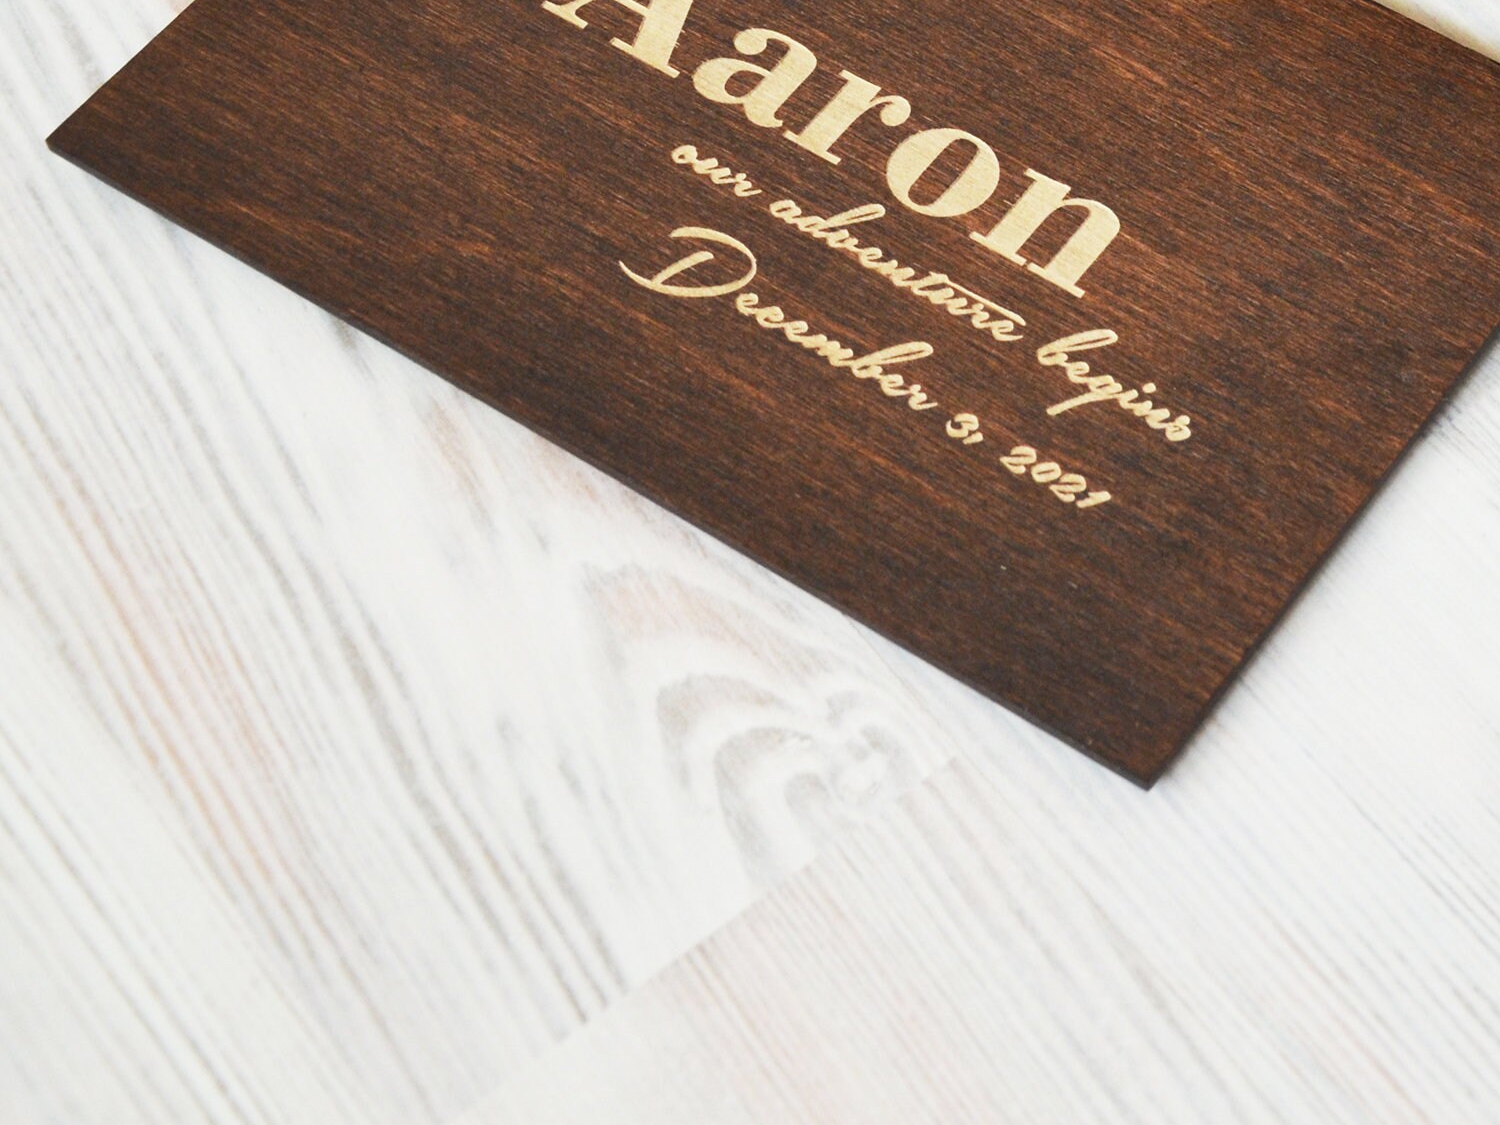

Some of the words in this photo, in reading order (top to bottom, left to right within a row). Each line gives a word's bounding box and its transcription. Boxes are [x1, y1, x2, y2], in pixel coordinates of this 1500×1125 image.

[618, 226, 939, 411] December
[999, 445, 1112, 508] 2021
[671, 144, 763, 197] our
[769, 203, 1027, 342] adventure
[1037, 328, 1192, 442] begins
